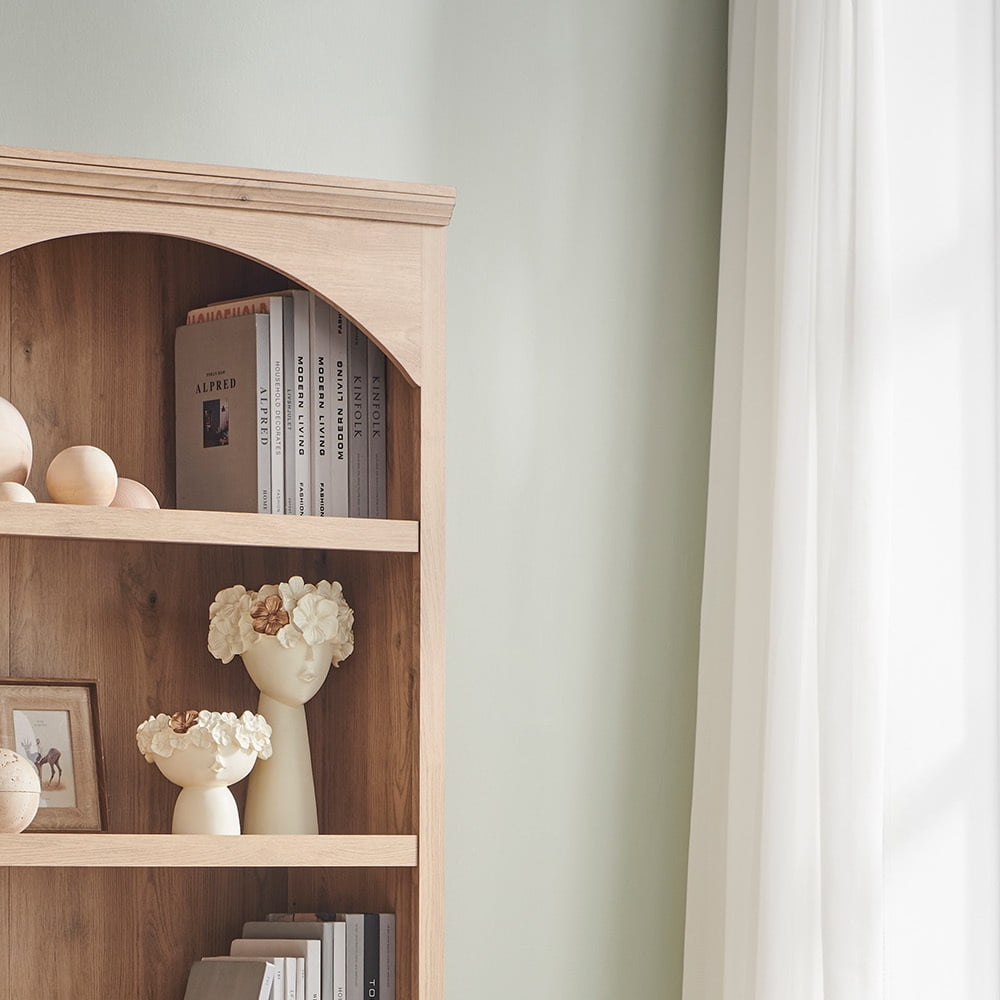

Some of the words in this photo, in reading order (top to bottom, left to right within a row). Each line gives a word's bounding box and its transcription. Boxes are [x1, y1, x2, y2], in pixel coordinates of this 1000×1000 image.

[196, 378, 236, 394] ALPRED
[353, 376, 362, 438] KINFOLK
[372, 376, 381, 438] KINFOLK
[260, 387, 268, 446] ALPRED
